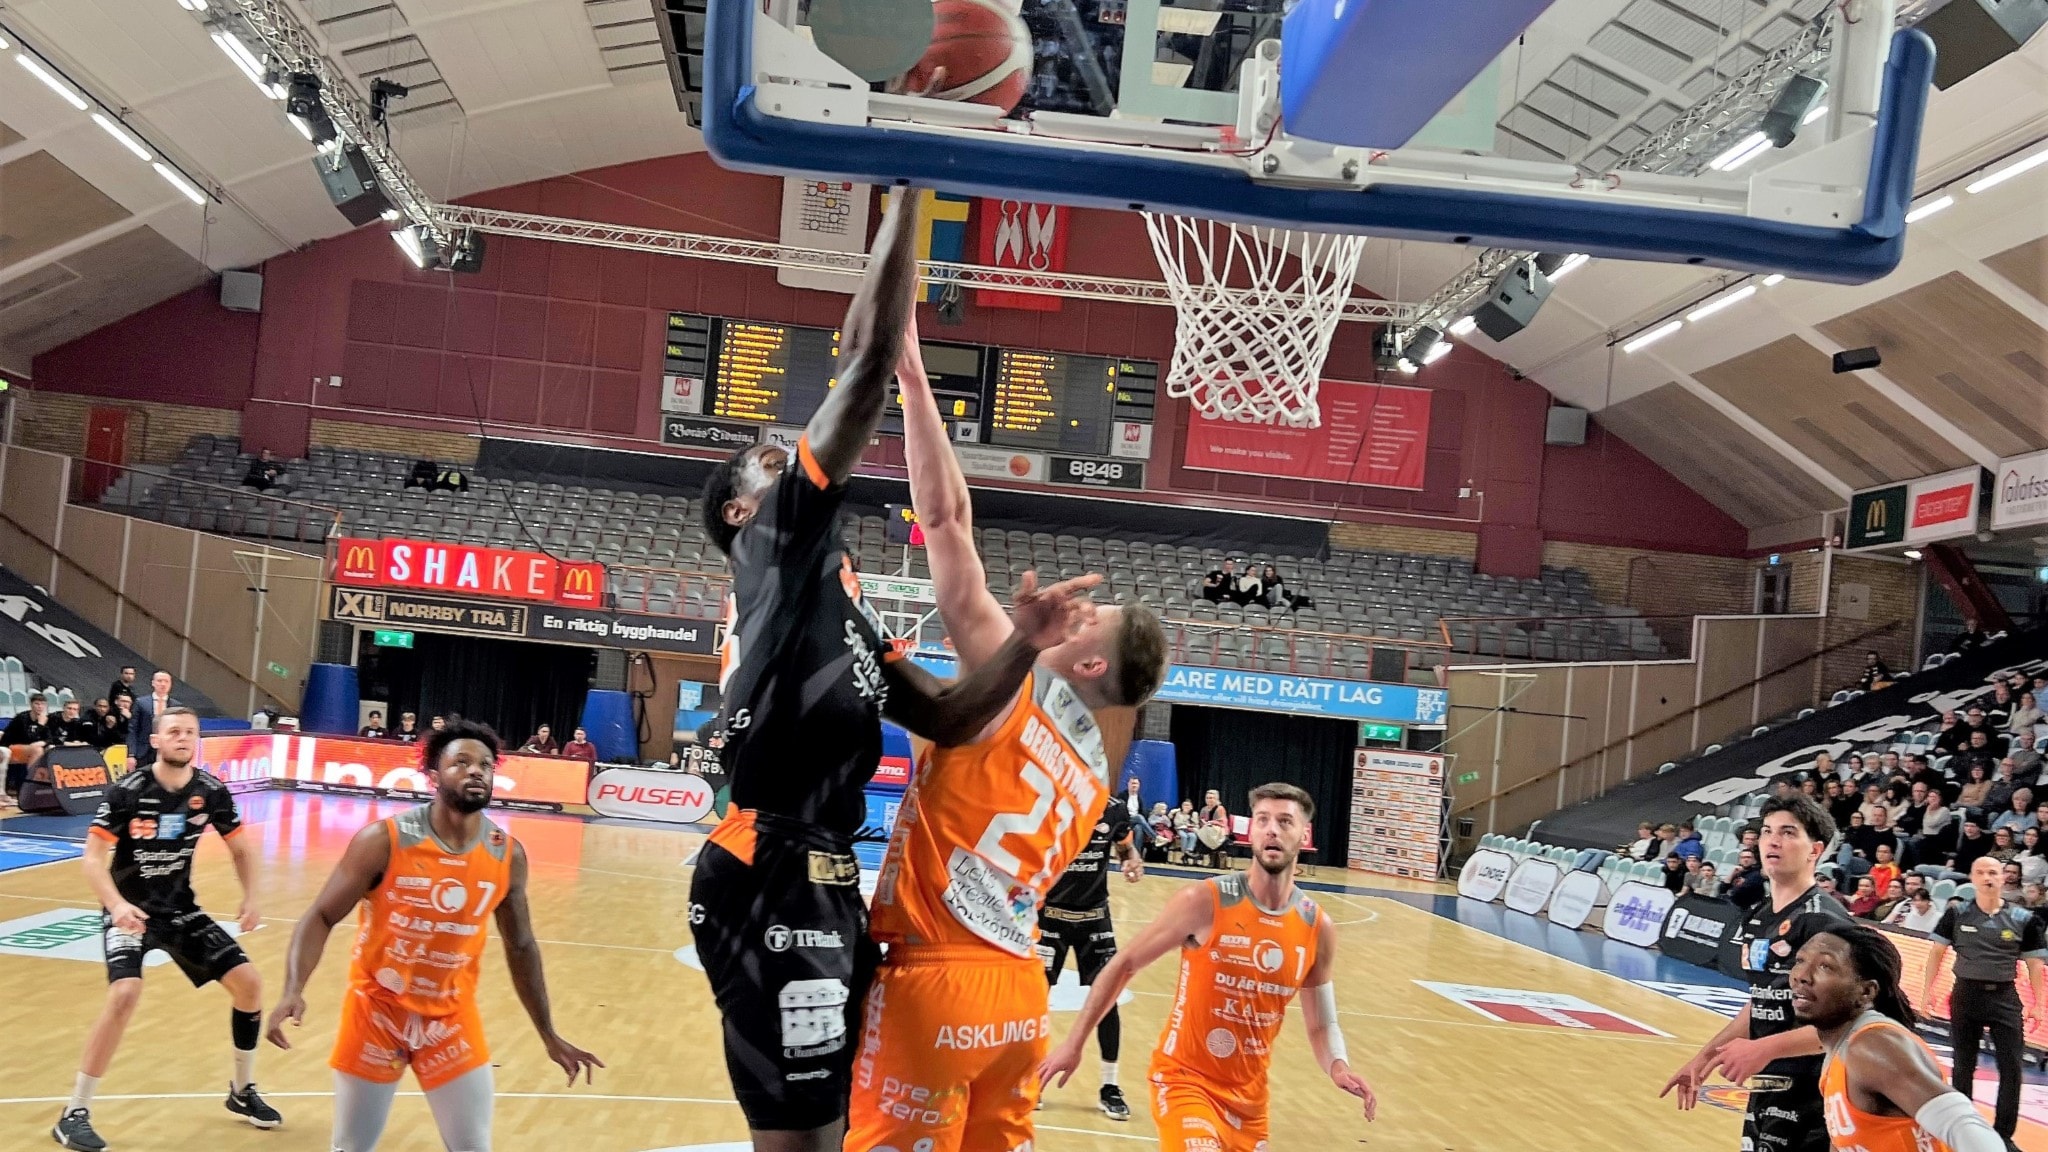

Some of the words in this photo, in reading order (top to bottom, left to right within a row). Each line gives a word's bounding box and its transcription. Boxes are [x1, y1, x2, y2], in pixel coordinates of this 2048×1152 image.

[670, 316, 686, 326] No.
[667, 345, 683, 356] No.
[1120, 363, 1135, 373] No.
[1117, 392, 1133, 402] No.
[1224, 446, 1248, 456] make
[1248, 450, 1264, 458] you
[1069, 460, 1123, 479] 8848
[390, 544, 547, 595] SHAKE
[390, 601, 466, 622] NORRBY
[543, 614, 564, 630] En
[567, 618, 609, 636] riktig
[612, 621, 698, 642] bygghandel
[1222, 674, 1274, 695] MED
[1279, 677, 1334, 701] RÄTT
[1338, 685, 1383, 705] LAG
[596, 784, 705, 808] PULSEN
[472, 880, 497, 917] 7
[1215, 972, 1237, 987] DU
[1237, 975, 1256, 991] ÄR
[934, 1019, 1036, 1050] ASKLING
[882, 1076, 930, 1103] pre
[878, 1094, 941, 1125] zero
